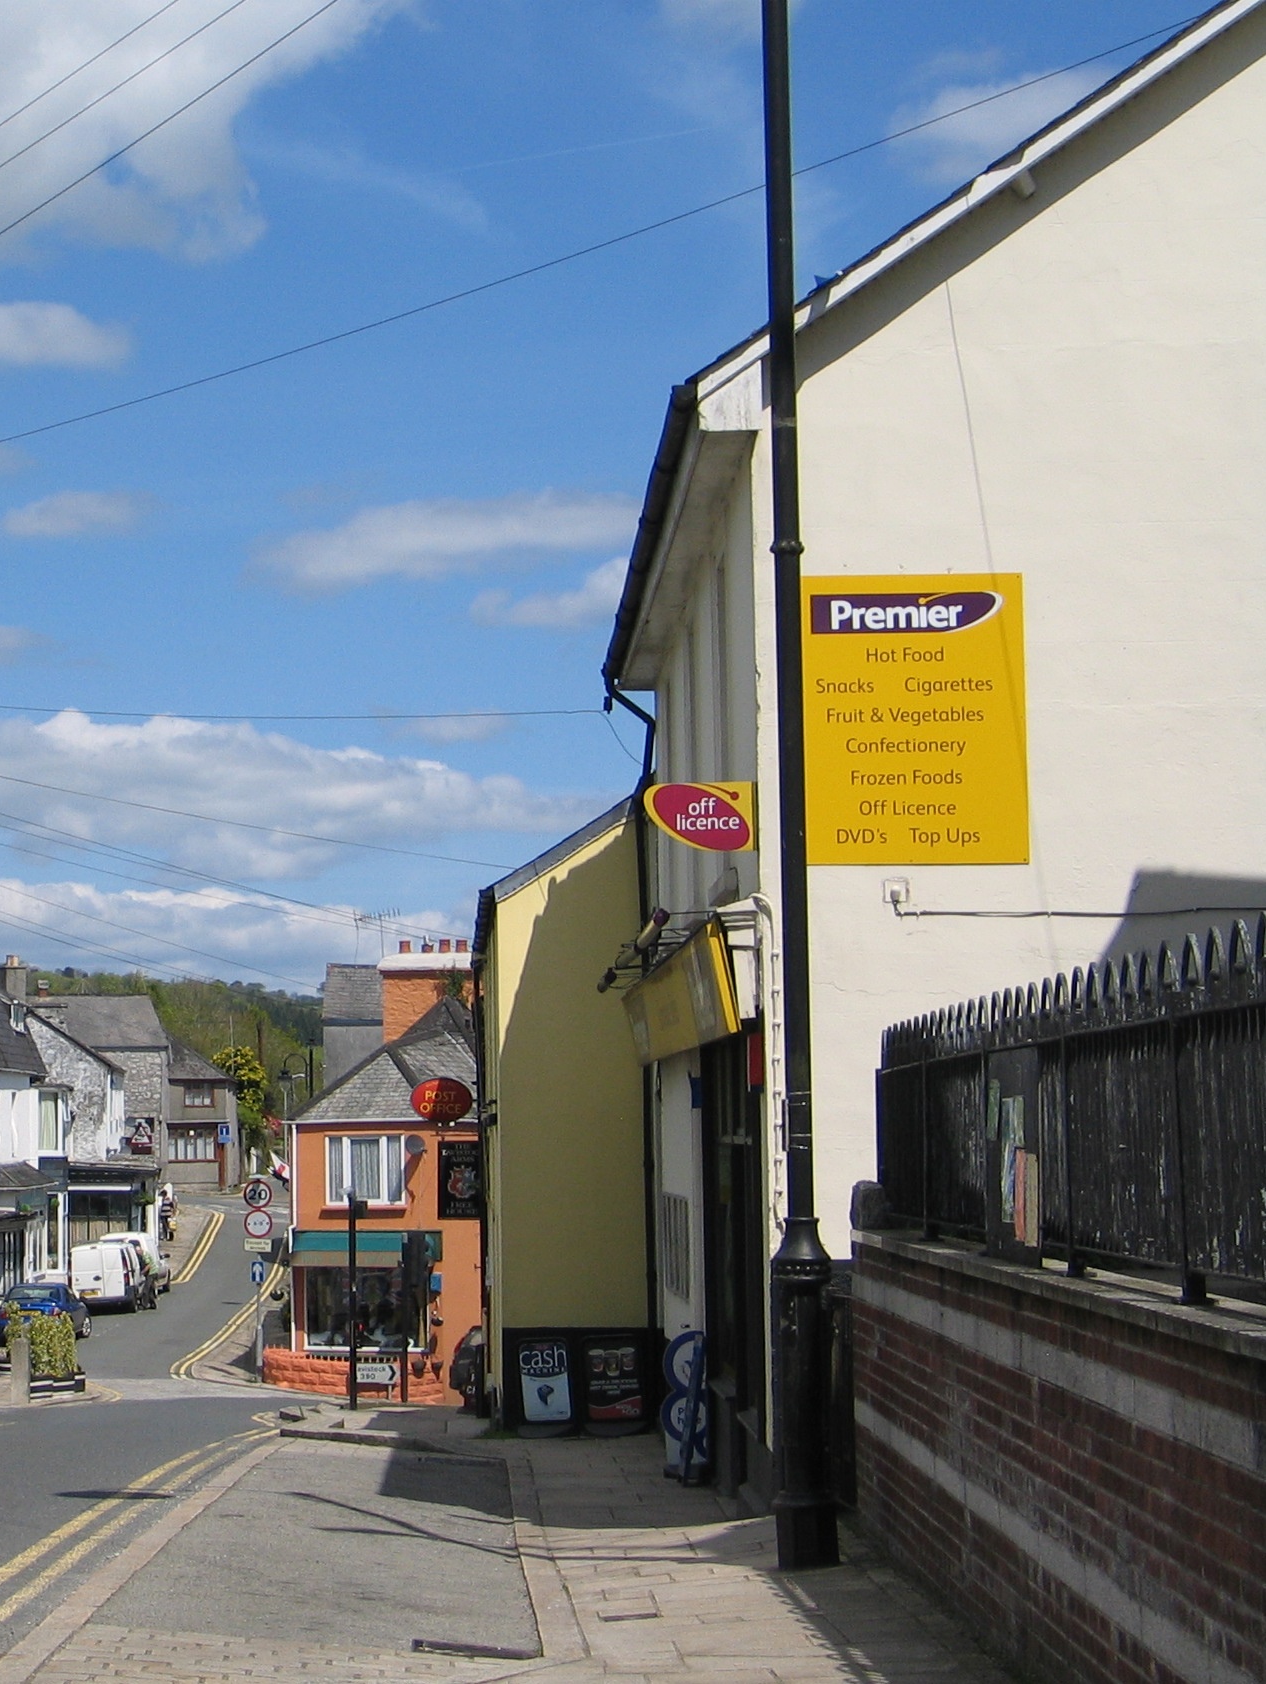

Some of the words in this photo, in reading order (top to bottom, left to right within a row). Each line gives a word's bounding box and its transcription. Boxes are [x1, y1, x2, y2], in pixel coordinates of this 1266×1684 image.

[830, 598, 963, 630] Premier
[866, 648, 897, 663] Hot
[902, 646, 945, 662] Food
[815, 678, 875, 694] Snacks
[904, 677, 993, 696] Cigarettes
[826, 707, 864, 723] Fruit
[870, 707, 884, 723] &
[889, 706, 984, 726] Vegetables
[845, 738, 967, 756] Confectionery
[851, 770, 907, 786] Frozen
[912, 769, 963, 785] Foods
[688, 797, 717, 816] off
[859, 800, 887, 816] Off
[893, 800, 957, 816] Licence
[676, 813, 740, 831] licence
[836, 828, 888, 844] DVD's
[909, 828, 941, 847] Top
[946, 828, 981, 847] Ups
[425, 1090, 456, 1102] POST
[420, 1102, 462, 1114] OFFICE
[248, 1188, 267, 1200] 20
[520, 1346, 567, 1368] cash
[358, 1365, 386, 1373] avistock
